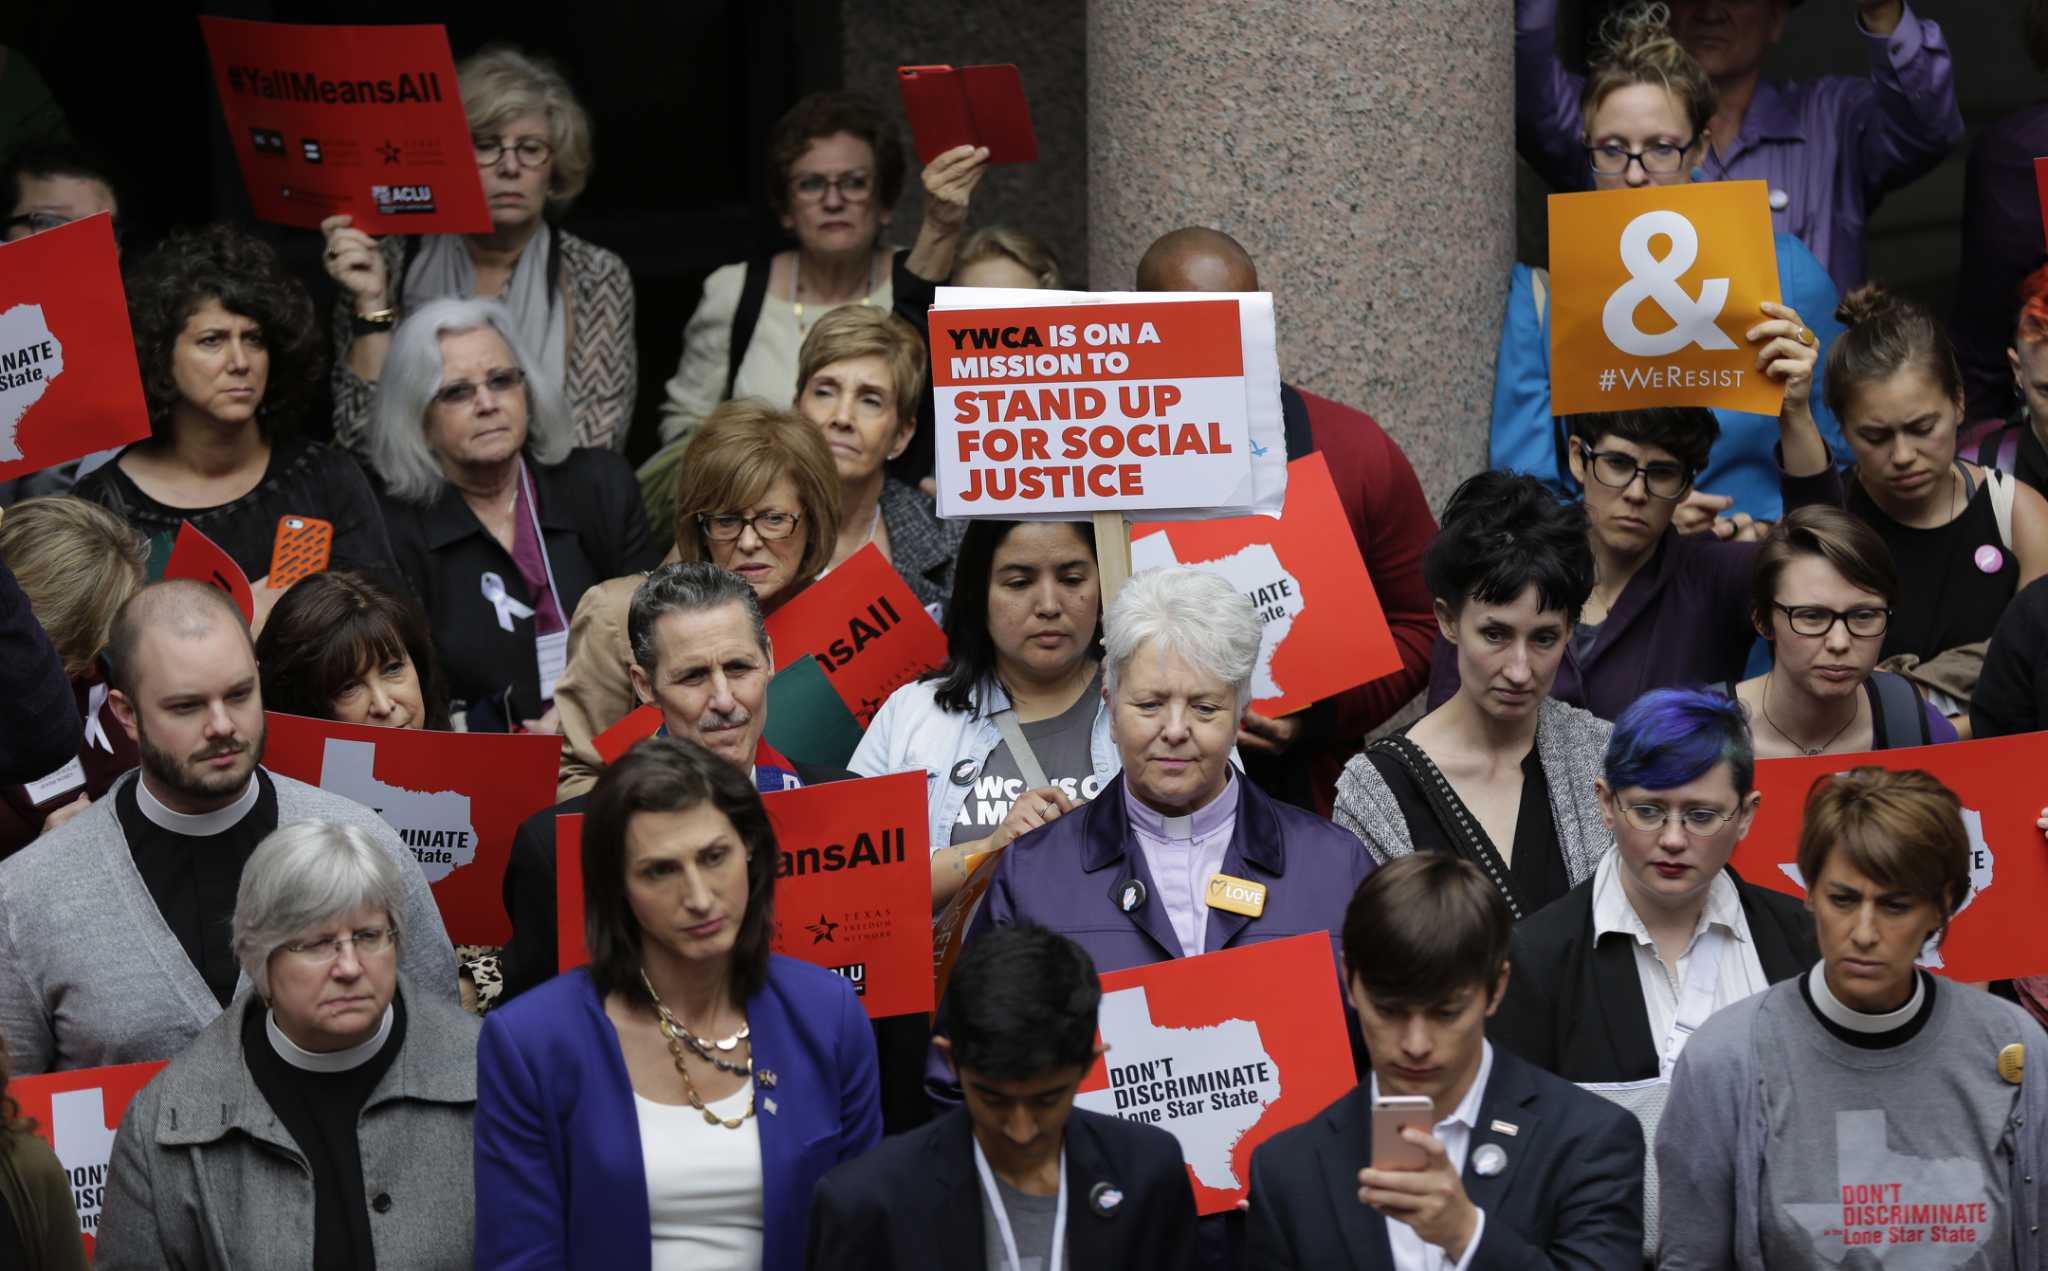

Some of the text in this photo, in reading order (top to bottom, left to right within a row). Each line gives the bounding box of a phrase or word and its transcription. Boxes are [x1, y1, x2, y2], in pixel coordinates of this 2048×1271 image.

[227, 66, 441, 104] #YallMeansAll
[947, 322, 1161, 350] YWCA IS ON A
[0, 340, 53, 373] NATE
[950, 352, 1129, 379] MISSION TO
[954, 385, 1182, 424] STAND UP
[957, 422, 1232, 462] FOR SOCIAL
[959, 464, 1144, 502] JUSTICE
[1225, 883, 1263, 905] LOVE
[1110, 1057, 1173, 1088] DON'T
[1114, 1062, 1270, 1110] DISCRIMINATE
[1167, 1099, 1205, 1120] Star
[1210, 1088, 1259, 1111] State
[1842, 1184, 1903, 1204] DON'T
[1843, 1202, 1987, 1227] DISCRIMINATE
[1843, 1228, 1882, 1245] Lone
[1888, 1226, 1925, 1244] Star
[1931, 1225, 1976, 1243] State
